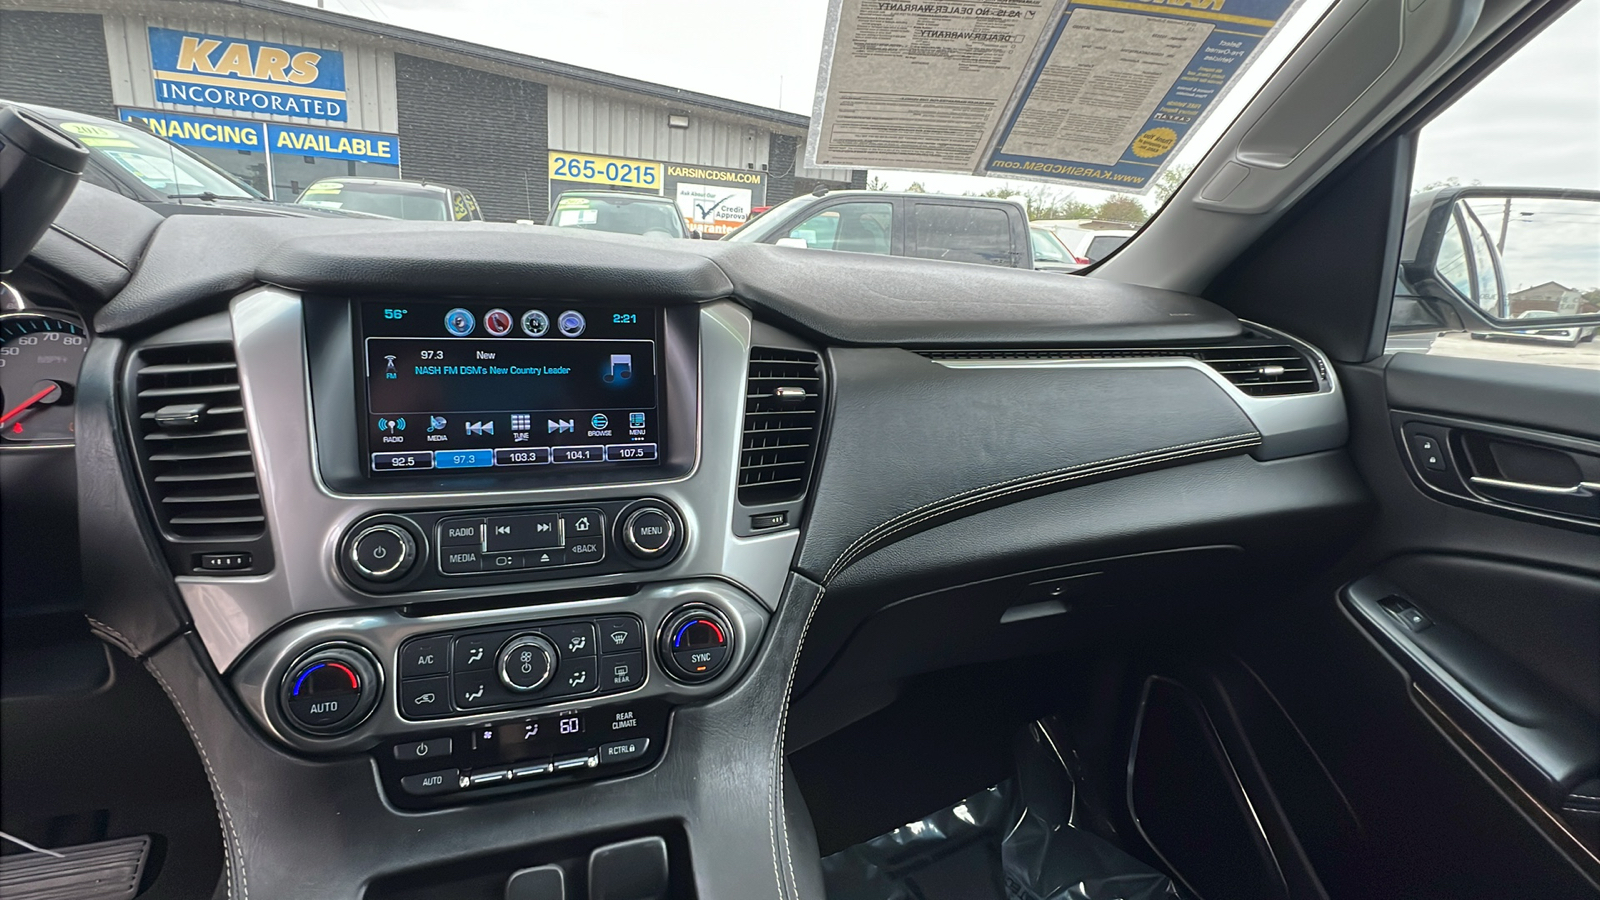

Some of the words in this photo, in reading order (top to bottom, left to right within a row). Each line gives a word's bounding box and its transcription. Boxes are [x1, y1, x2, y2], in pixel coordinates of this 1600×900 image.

[176, 36, 322, 85] KARS
[162, 82, 341, 117] INCORPORATED
[128, 116, 259, 146] NANCING
[276, 130, 391, 158] AVAILABLE
[553, 156, 656, 185] 265-0215
[667, 166, 761, 184] KARSINCDSM.COM
[720, 205, 744, 213] Credit
[384, 308, 408, 319] 56°
[612, 313, 637, 324] 2:21
[18, 337, 38, 345] 60
[42, 332, 60, 341] 70
[63, 337, 82, 345] 80
[420, 350, 444, 359] 97.3
[476, 350, 496, 360] New
[415, 366, 441, 375] NASH
[443, 366, 458, 375] FM
[460, 366, 488, 375] DSM's
[489, 366, 509, 375] New
[509, 366, 541, 376] Country
[543, 366, 571, 375] Leader
[513, 432, 530, 440] TUNE
[509, 452, 537, 462] 103.3
[565, 450, 590, 460] 104.1
[619, 448, 644, 458] 107.5
[391, 457, 415, 467] 92.5
[453, 455, 475, 464] 97.3
[449, 527, 475, 537] RADIO
[640, 526, 663, 536] MENU
[577, 544, 597, 553] BACK
[449, 553, 476, 563] MEDIA
[417, 655, 434, 665] A/C
[691, 652, 711, 663] SYNC
[614, 675, 630, 683] REAR
[310, 701, 338, 714] AUTO
[615, 711, 634, 721] REAR
[560, 717, 579, 734] 60
[612, 718, 637, 730] CLIMATE
[422, 776, 443, 787] AUTO
